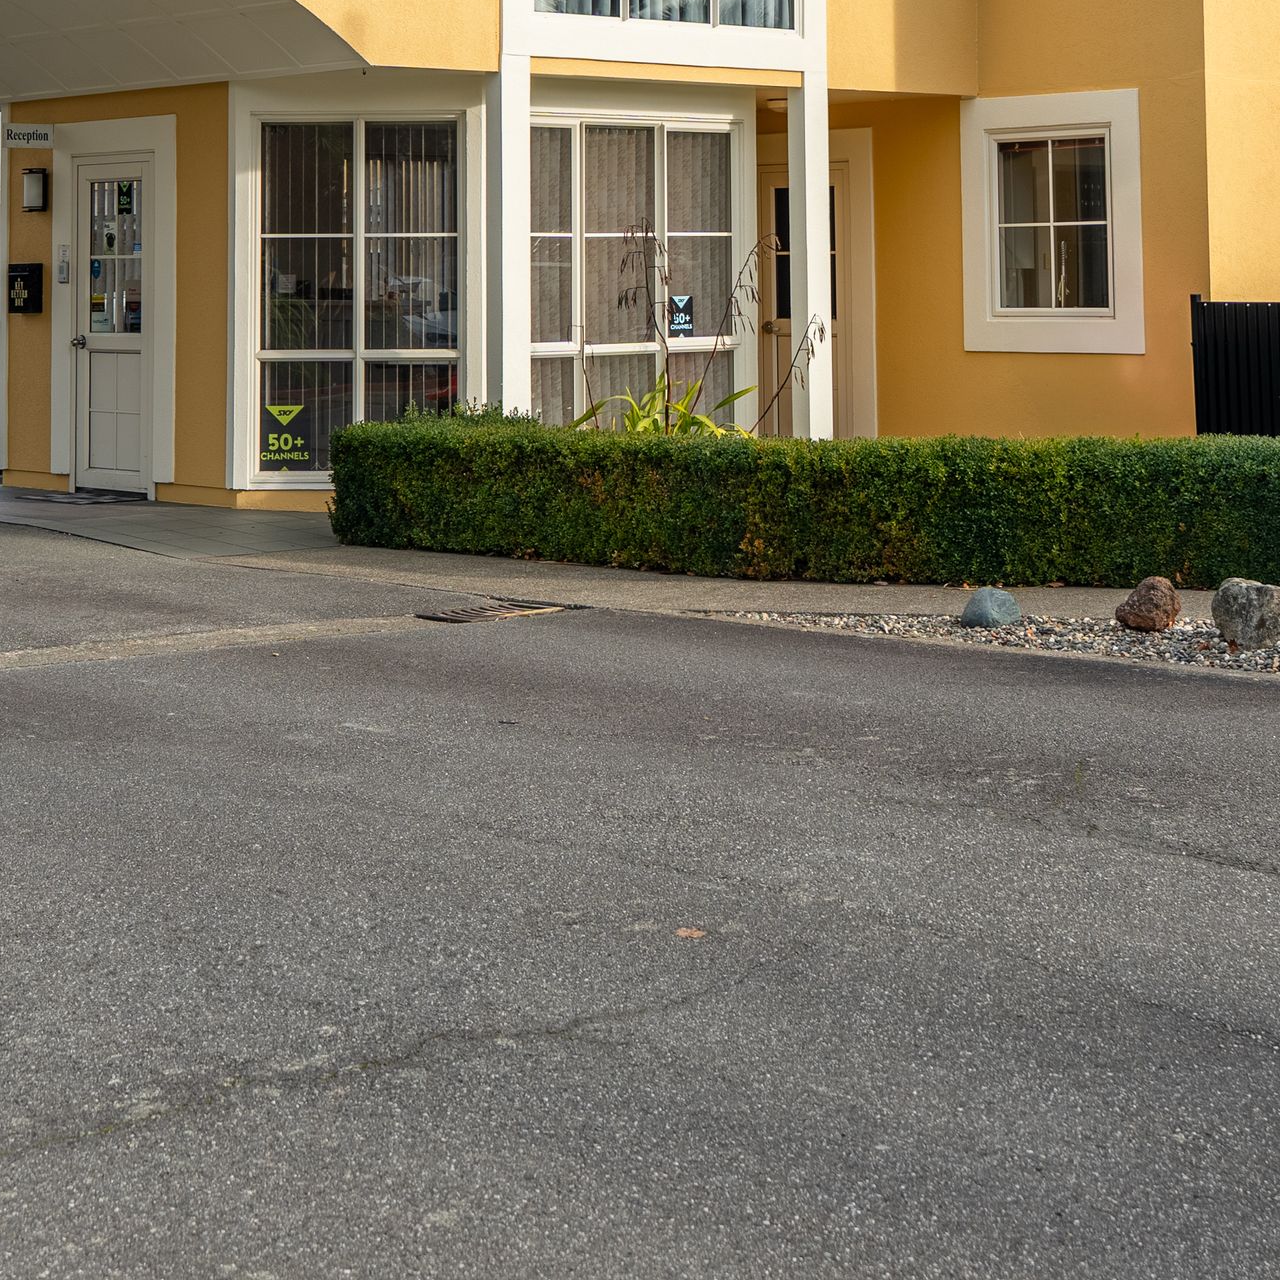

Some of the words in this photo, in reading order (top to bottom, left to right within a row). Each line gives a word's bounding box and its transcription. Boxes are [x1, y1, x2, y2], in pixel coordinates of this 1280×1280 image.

[6, 128, 49, 144] Reception
[674, 313, 690, 323] 50+
[268, 433, 305, 451] 50+
[260, 452, 310, 460] CHANNELS
